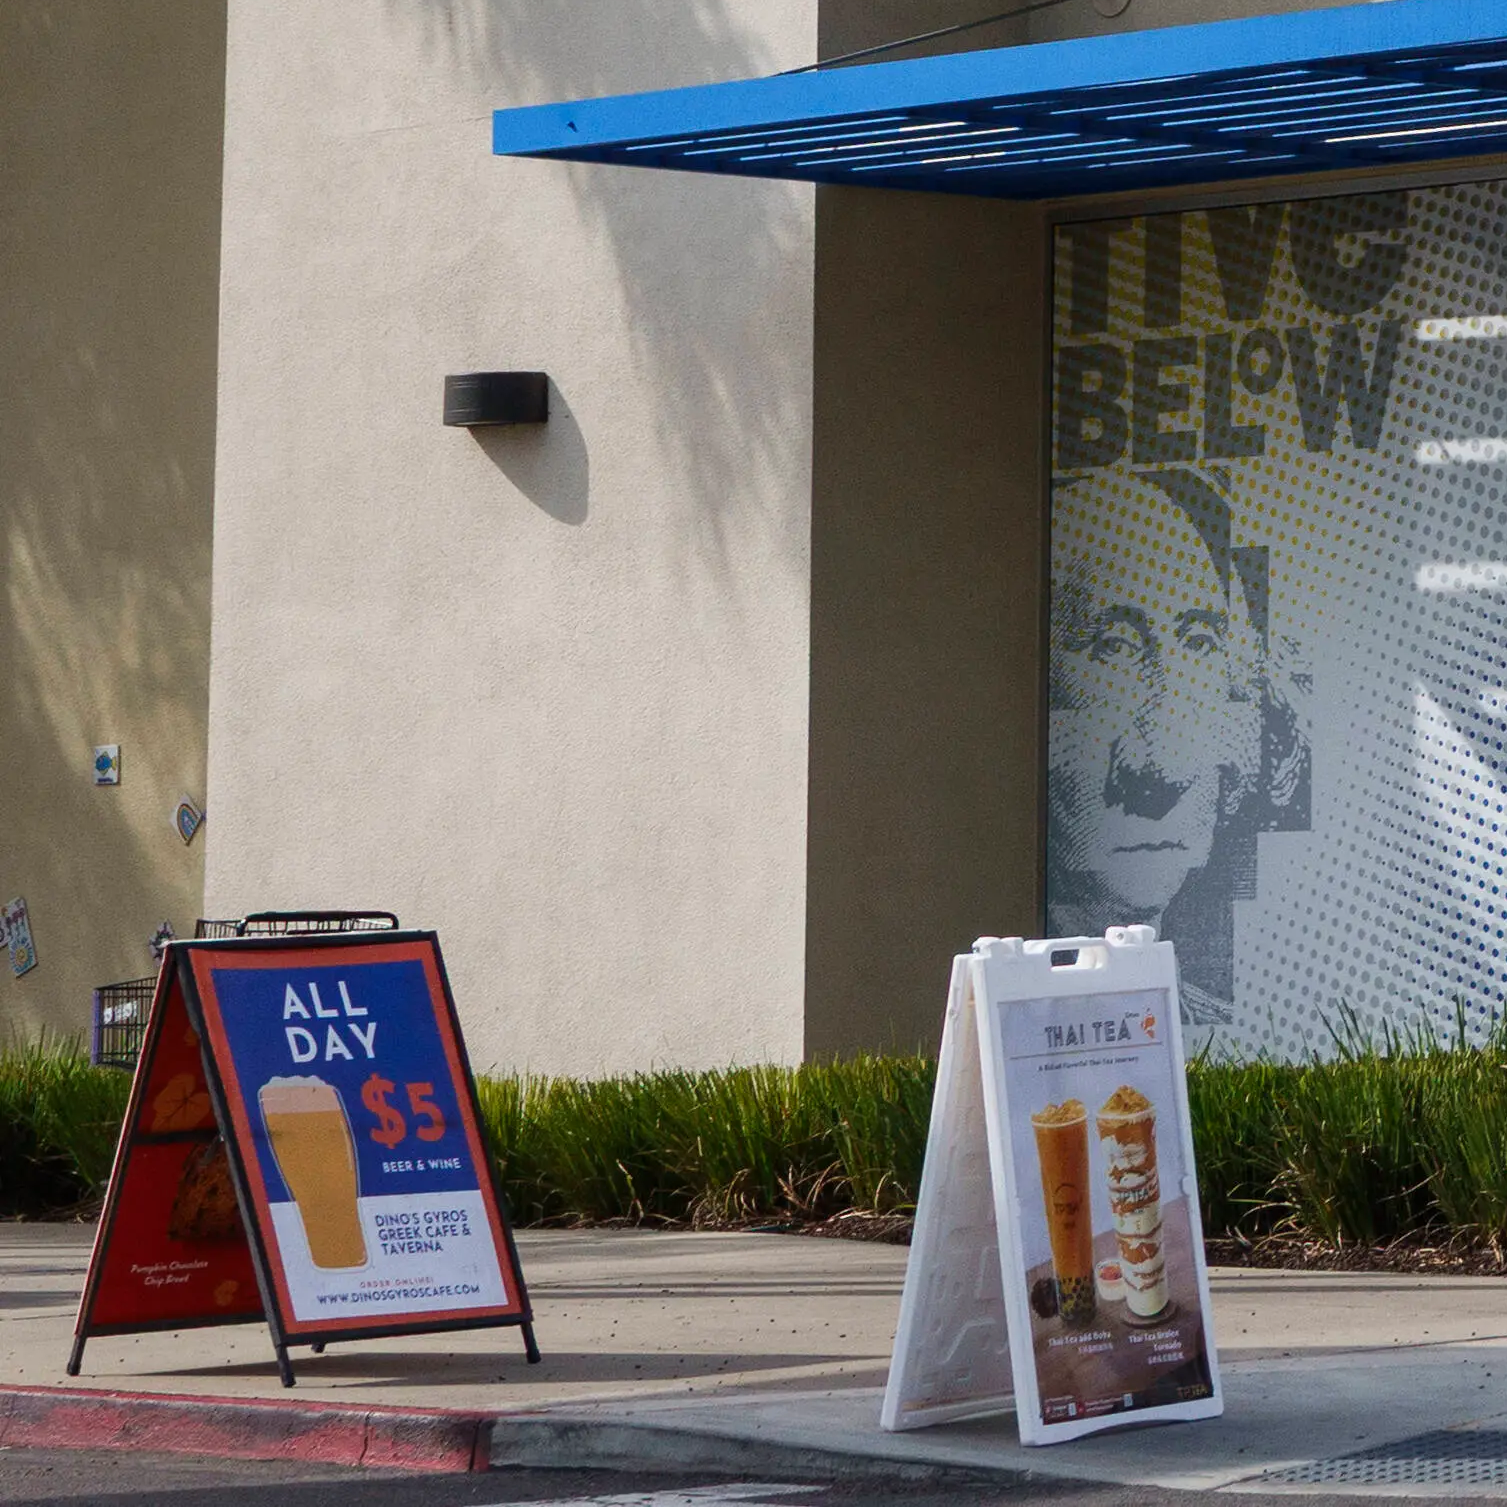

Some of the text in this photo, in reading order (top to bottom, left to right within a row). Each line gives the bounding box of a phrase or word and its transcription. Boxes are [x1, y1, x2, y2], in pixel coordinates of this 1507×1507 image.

[1057, 318, 1403, 471] BELOW
[282, 980, 369, 1020] ALL
[284, 1022, 377, 1063] DAY
[1043, 1018, 1132, 1048] THAI TEA
[360, 1071, 447, 1150] $5
[382, 1157, 462, 1174] BEER & WINE
[374, 1209, 468, 1227] DINO'S GYROS
[378, 1223, 472, 1242] GREEK CAFE &
[380, 1240, 444, 1256] TAVERNA
